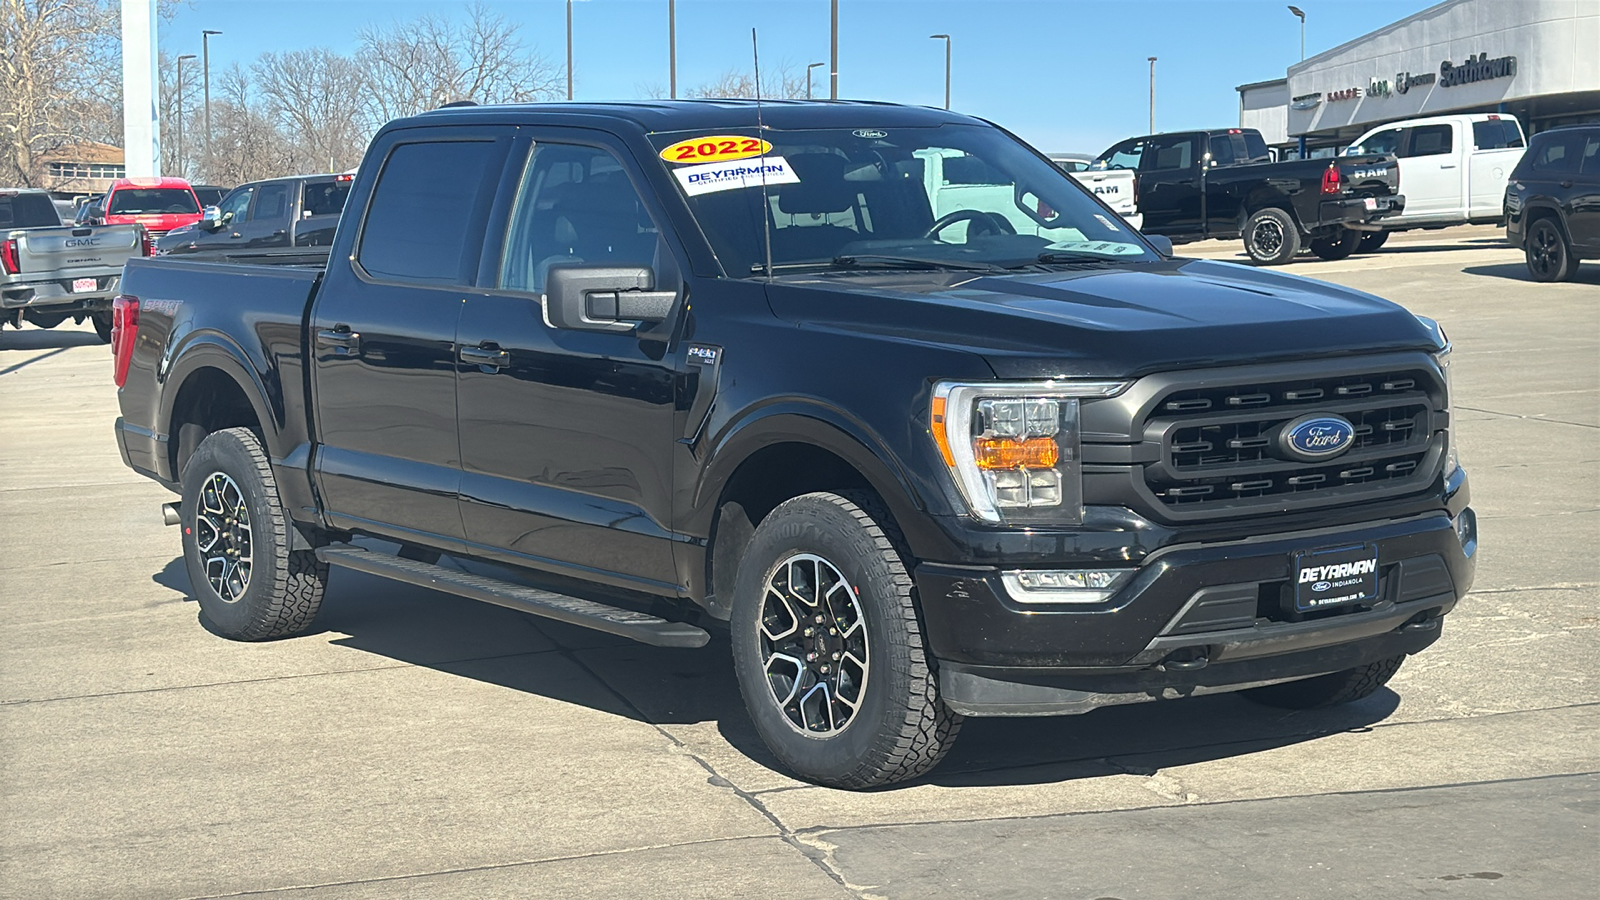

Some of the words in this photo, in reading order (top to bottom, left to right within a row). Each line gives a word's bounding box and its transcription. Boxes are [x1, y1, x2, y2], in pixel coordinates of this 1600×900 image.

[1440, 52, 1517, 88] Southtown
[676, 139, 760, 160] 2022
[688, 164, 783, 184] DEYARMAN
[1354, 168, 1388, 179] RAM
[1089, 185, 1119, 195] AM
[65, 238, 101, 248] GMC
[142, 298, 184, 315] SPORT
[1305, 426, 1341, 448] Ford
[1298, 558, 1377, 584] DEYARMAN
[1332, 577, 1363, 588] INDIANOLA
